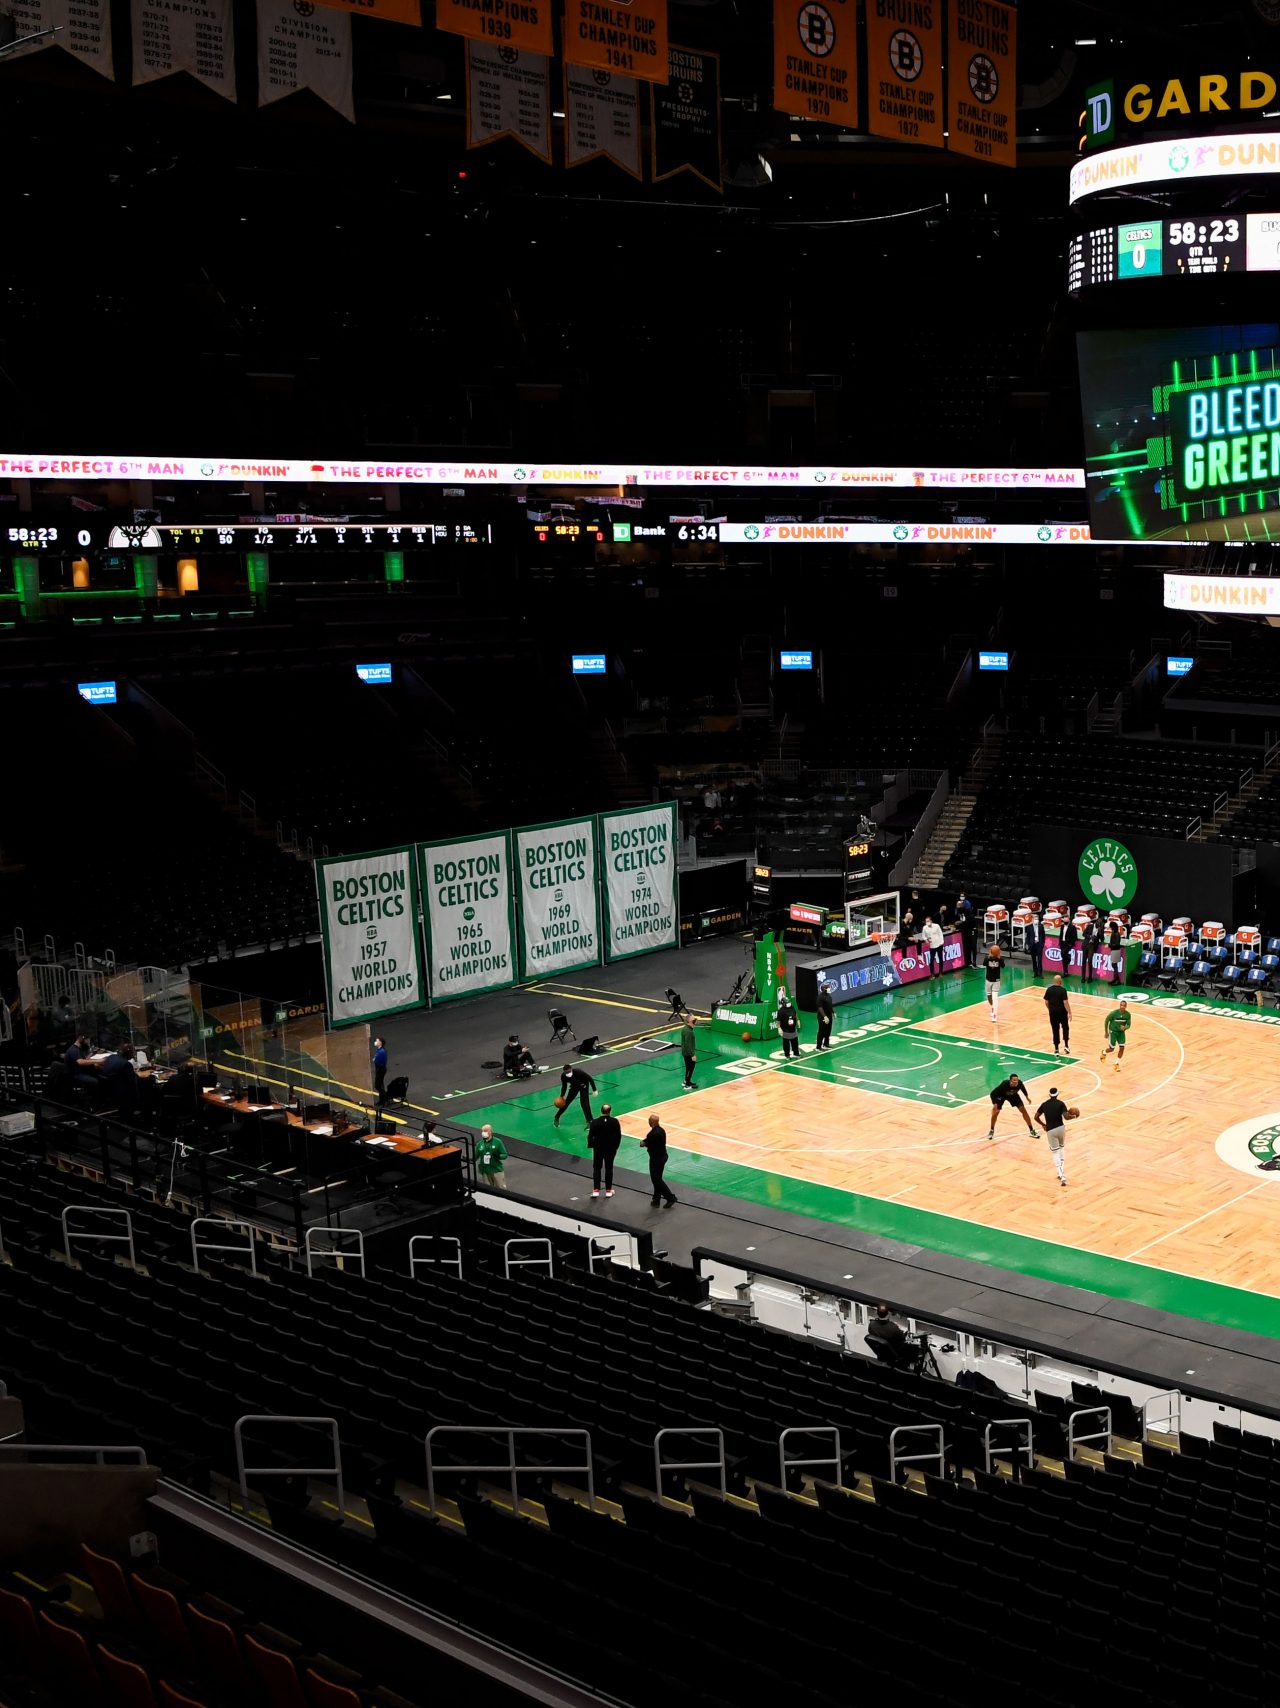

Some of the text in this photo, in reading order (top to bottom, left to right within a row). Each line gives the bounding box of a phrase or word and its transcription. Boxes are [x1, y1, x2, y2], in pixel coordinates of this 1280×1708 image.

[148, 0, 216, 19] CHAMPIONS
[580, 1, 656, 36] STANLEY CUP
[957, 0, 1009, 31] BOSTON
[274, 25, 336, 45] CHAMPIONS
[281, 16, 328, 33] DIVISION
[480, 16, 512, 39] 1939
[580, 22, 656, 56] CHAMPIONS
[957, 22, 1009, 56] BRUINS
[606, 49, 634, 71] 1941
[786, 56, 847, 83] STANLEY CUP
[785, 76, 848, 103] CHAMPIONS
[880, 82, 934, 106] STANLEY CUP
[808, 98, 830, 116] 1970
[880, 98, 935, 124] CHAMPIONS
[957, 102, 1008, 127] STANLEY CUP
[1088, 93, 1112, 134] TD
[898, 121, 919, 137] 1972
[957, 119, 1008, 144] CHAMPIONS
[974, 140, 992, 156] 2011
[1084, 154, 1142, 186] DUNKIN'
[1126, 230, 1153, 242] CELTICS
[1170, 220, 1239, 245] 58:23
[1133, 244, 1146, 269] 0
[1190, 247, 1203, 257] QTR
[0, 460, 290, 477] THE PERFECT 6TH MAN DUNKIN'
[331, 466, 603, 480] THE PERFECT 6TH MAN DUNKIN'
[644, 469, 898, 482] THE PERFECT 6TH MAN DUNKIN'
[930, 472, 1075, 484] THE PERFECT 6TH MAN
[9, 528, 91, 546] 58:23 0
[219, 535, 318, 545] 50 1/2 1/1
[555, 525, 580, 534] 58:23
[634, 525, 717, 540] Bank 6:34
[779, 526, 849, 538] DUNKIN'
[927, 526, 997, 539] DUNKIN'
[1190, 584, 1274, 605] DUNKIN'
[91, 686, 114, 696] TUFTS
[611, 823, 667, 851] BOSTON
[525, 838, 586, 868] BOSTON
[614, 845, 666, 874] CELTICS
[849, 845, 869, 857] 58:23
[1082, 842, 1134, 874] CELTICS
[433, 854, 500, 885] BOSTON
[529, 861, 584, 891] CELTICS
[332, 870, 405, 902] BOSTON
[438, 878, 498, 908] CELTICS
[630, 887, 652, 904] 1974
[337, 895, 404, 926] CELTICS
[548, 904, 571, 922] 1969
[624, 902, 660, 922] WORLD
[711, 912, 742, 925] GARDEN
[456, 923, 483, 941] 1965
[541, 919, 580, 941] WORLD
[614, 916, 672, 942] CHAMPIONS
[359, 941, 387, 960] 1957
[449, 939, 491, 961] WORLD
[530, 934, 593, 961] CHAMPIONS
[351, 958, 397, 982] WORLD
[438, 954, 507, 983] CHAMPIONS
[338, 973, 413, 1004] CHAMPIONS
